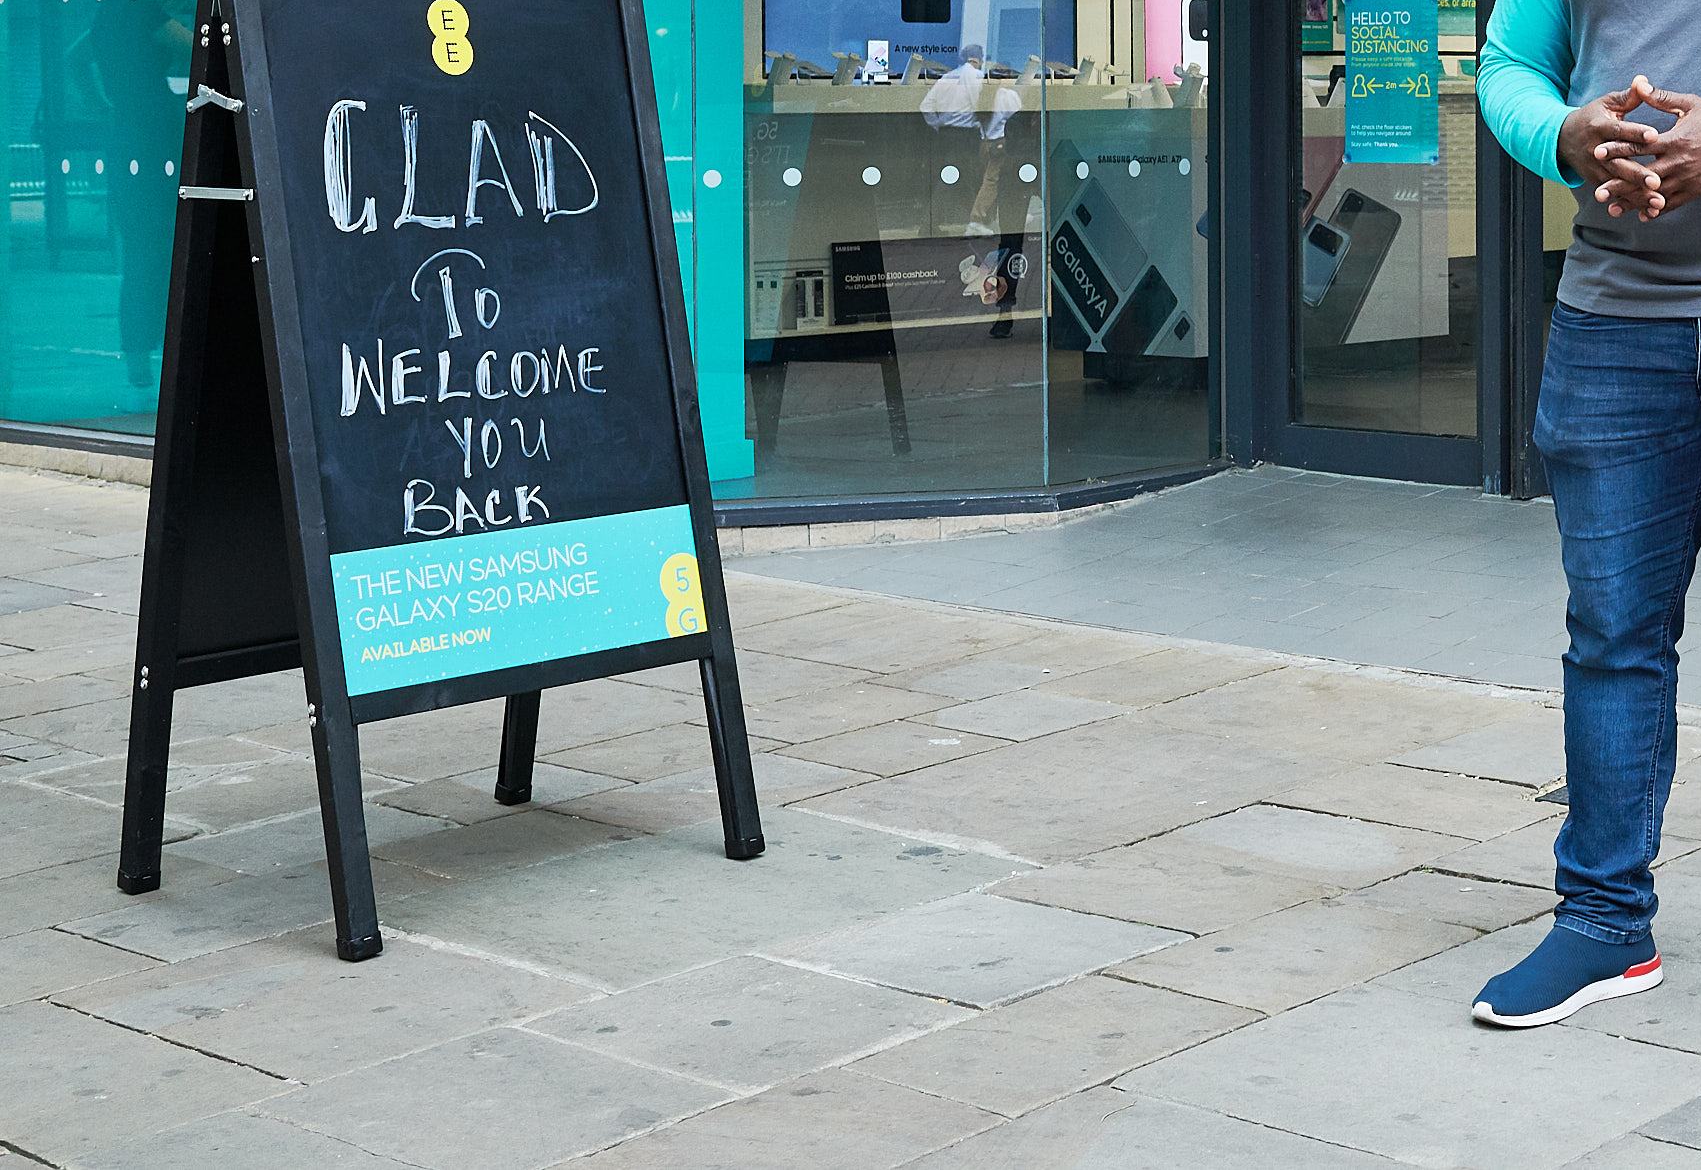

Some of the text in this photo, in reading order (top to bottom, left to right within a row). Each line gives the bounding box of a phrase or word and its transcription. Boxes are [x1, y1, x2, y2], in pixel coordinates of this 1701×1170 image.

[1352, 11, 1410, 25] HELLO TO
[1352, 26, 1399, 39] SOCIAL
[894, 43, 958, 55] A new style icon
[1352, 40, 1429, 54] DISTANCING
[1385, 81, 1397, 90] 2m
[1098, 155, 1130, 163] SAMSUNG
[844, 273, 866, 282] Claim
[867, 274, 877, 285] up
[886, 271, 901, 280] £100
[902, 269, 939, 278] cashback
[1055, 236, 1107, 318] Galaxy A
[340, 337, 606, 417] WELCOME
[444, 417, 551, 478] YOU
[403, 479, 550, 536] BACK
[350, 542, 588, 600] THE NEW SAMSUNG
[355, 570, 599, 632] GALAXY S20 RANGE
[360, 626, 491, 664] AVAILABLE NOW
